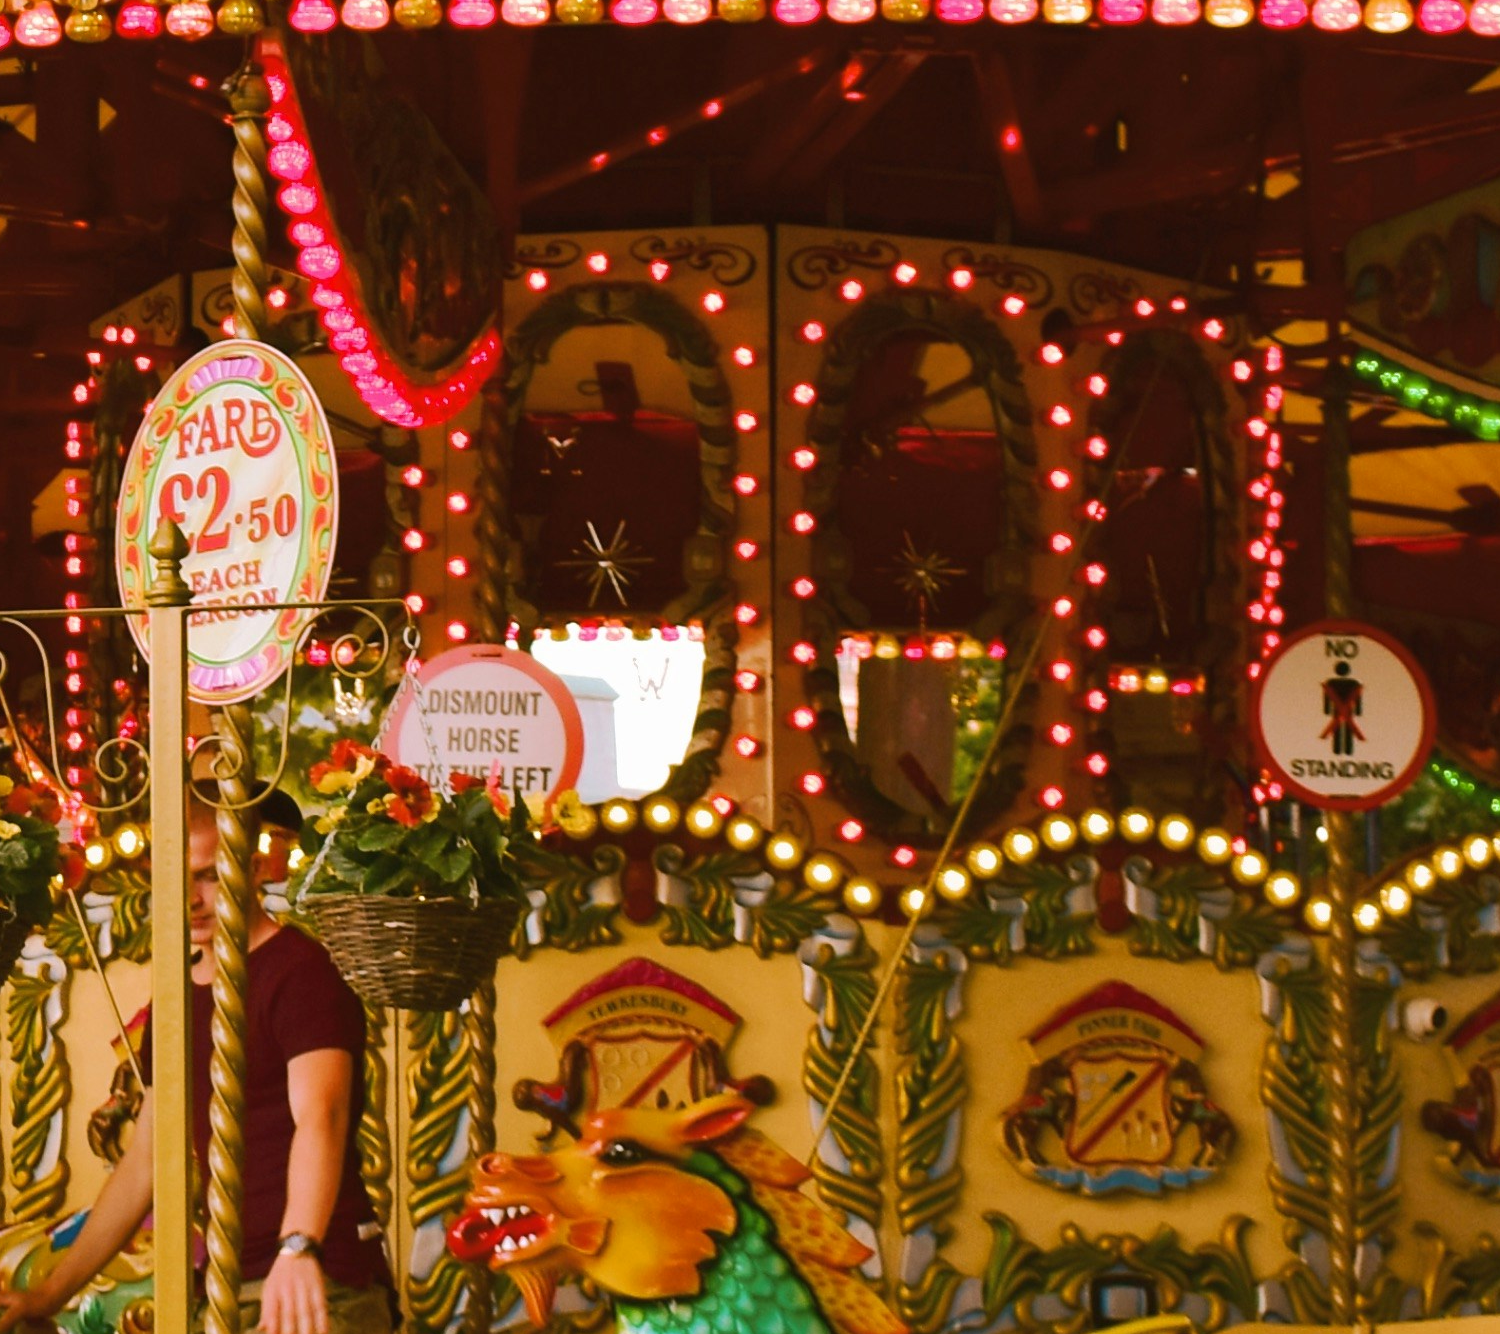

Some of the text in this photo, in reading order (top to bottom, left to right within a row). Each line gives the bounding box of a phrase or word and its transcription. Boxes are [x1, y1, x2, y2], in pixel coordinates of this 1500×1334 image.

[176, 398, 281, 459] FARE
[190, 560, 263, 597] EACH
[189, 587, 279, 628] ERSON
[1324, 639, 1359, 658] NO
[428, 689, 543, 716] DISMOUNT
[447, 727, 520, 753] HORSE
[500, 767, 552, 791] LEFT
[1290, 758, 1395, 780] STANDING
